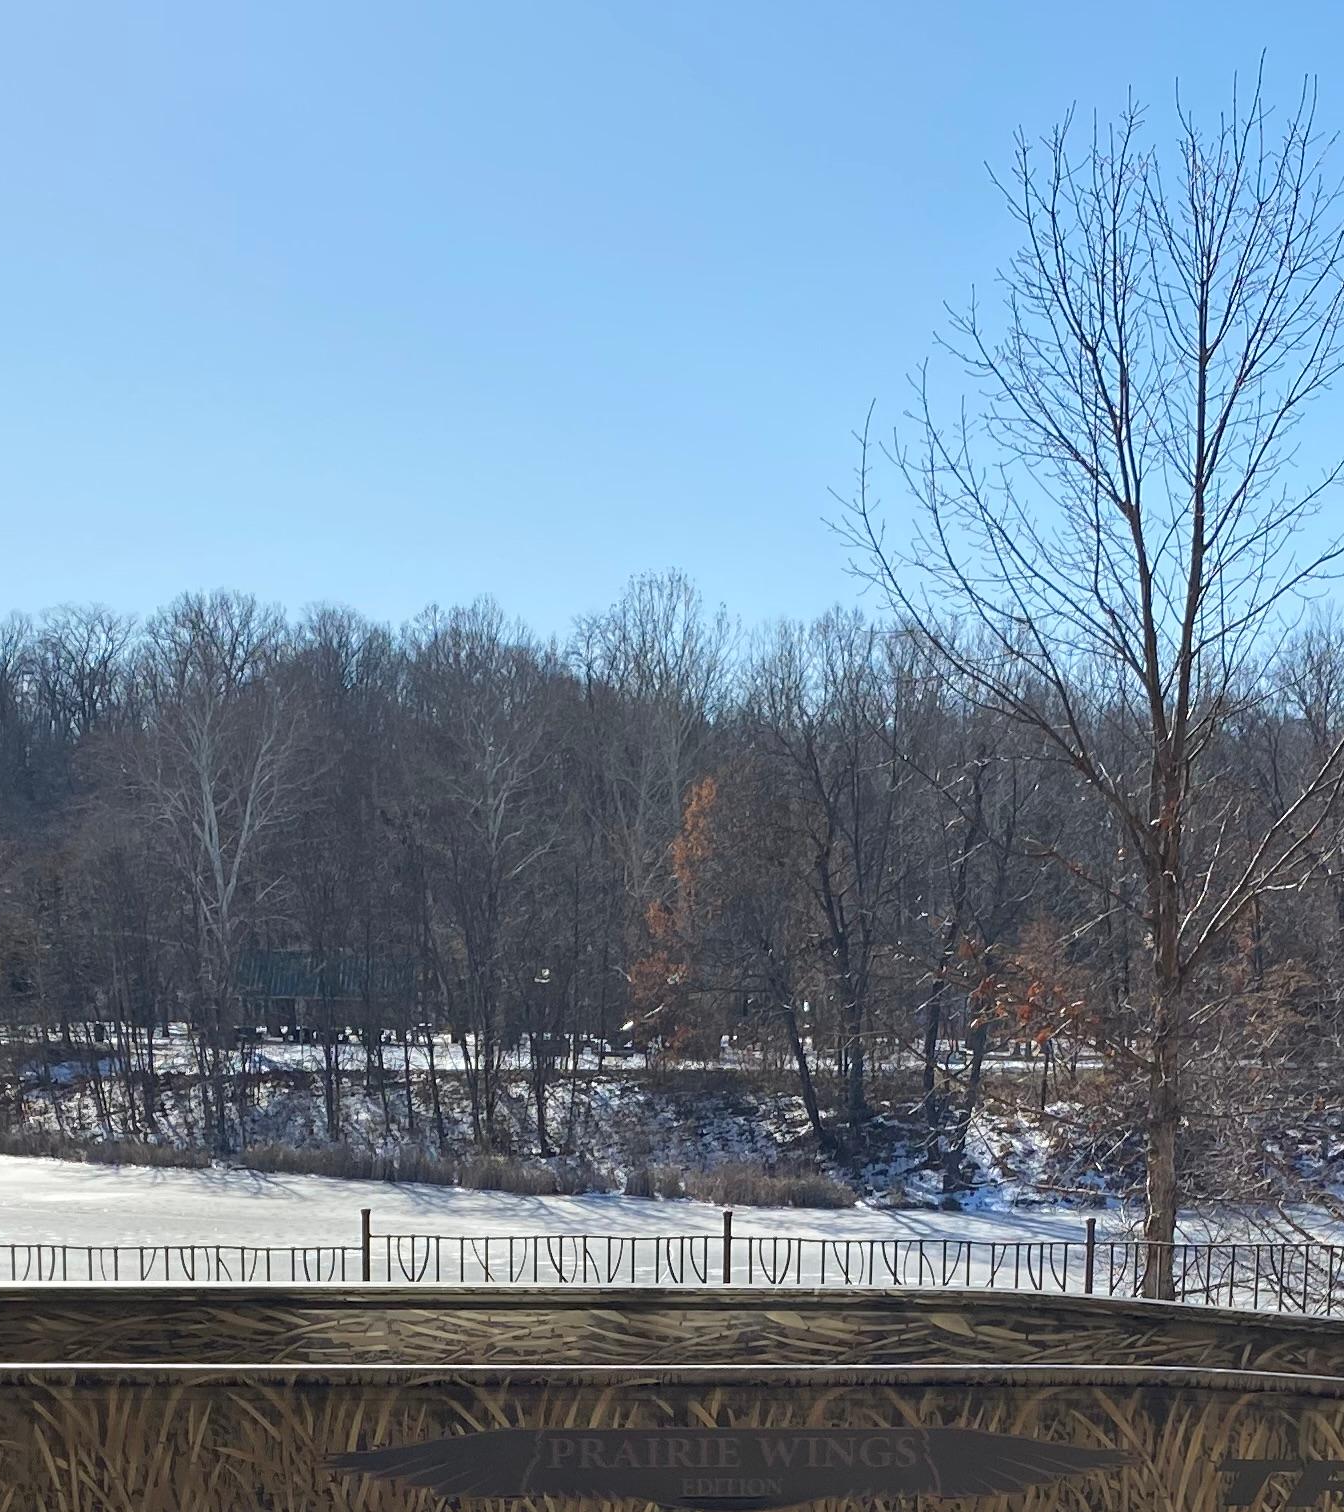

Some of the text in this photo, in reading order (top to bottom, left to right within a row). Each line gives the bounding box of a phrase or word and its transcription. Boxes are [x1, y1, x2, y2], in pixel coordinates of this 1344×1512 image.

[550, 1436, 917, 1469] PRAIRIE WINGS
[684, 1477, 781, 1496] EDITION
